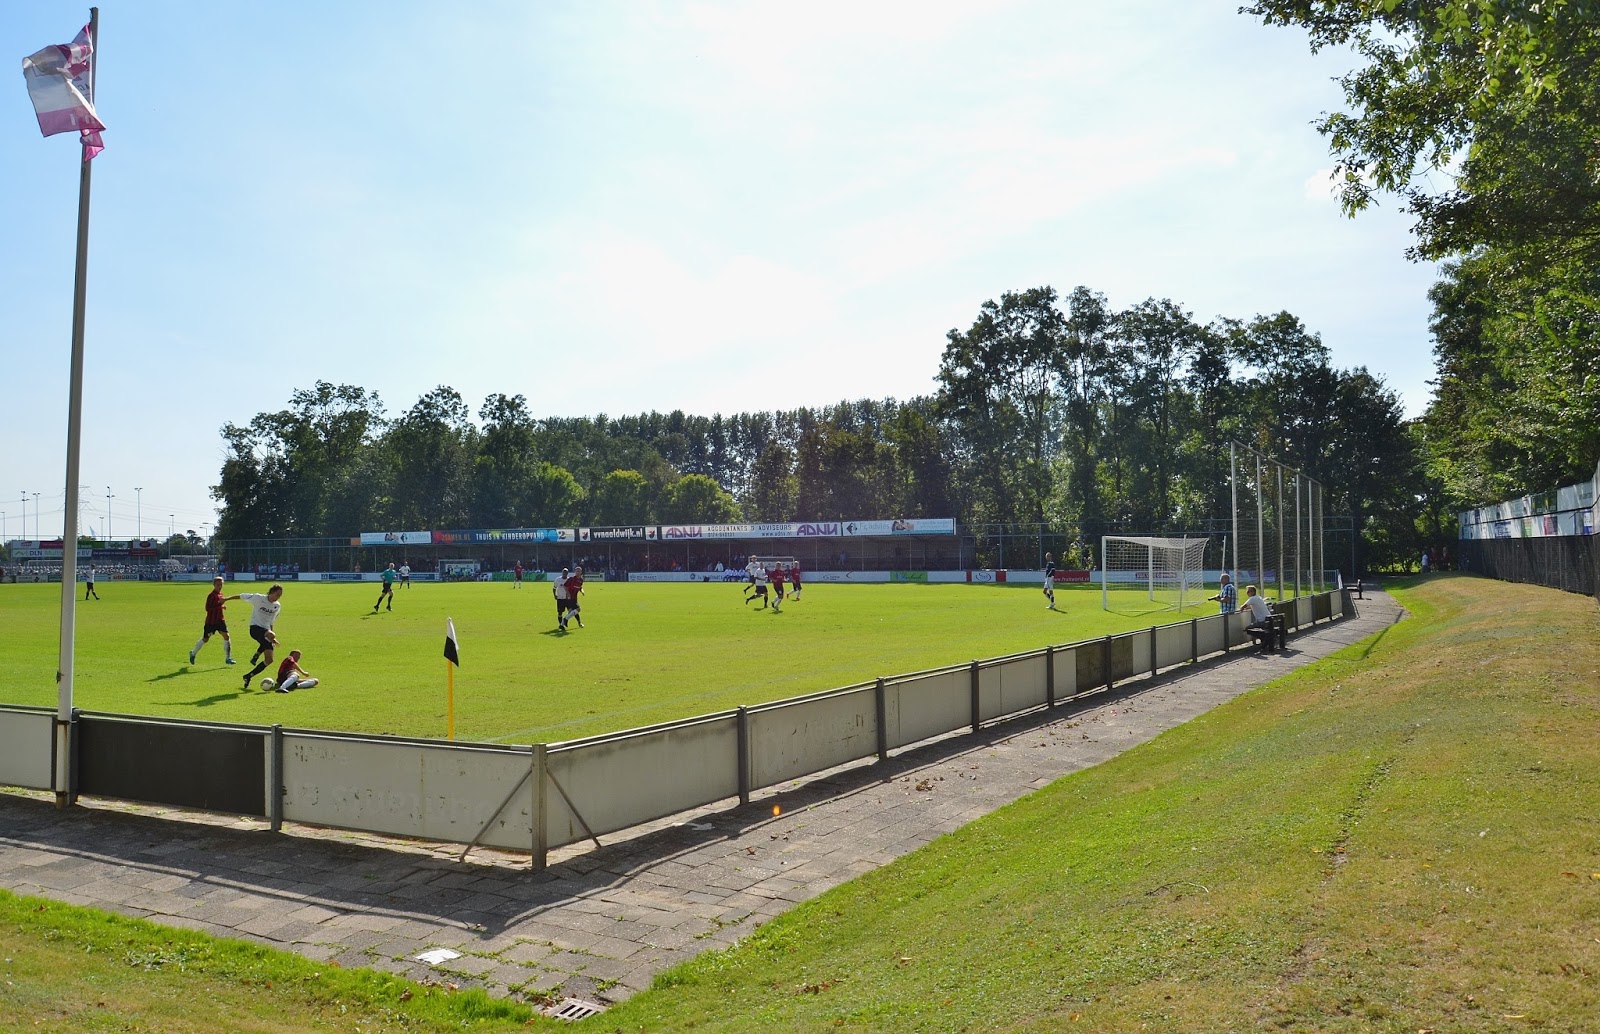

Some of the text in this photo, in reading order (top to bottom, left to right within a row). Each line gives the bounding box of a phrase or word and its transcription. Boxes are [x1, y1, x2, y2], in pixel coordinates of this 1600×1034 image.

[475, 533, 492, 541] THUIS
[501, 531, 545, 540] KINDEROPVANG
[593, 528, 643, 540] vvnaaldwijk.nl
